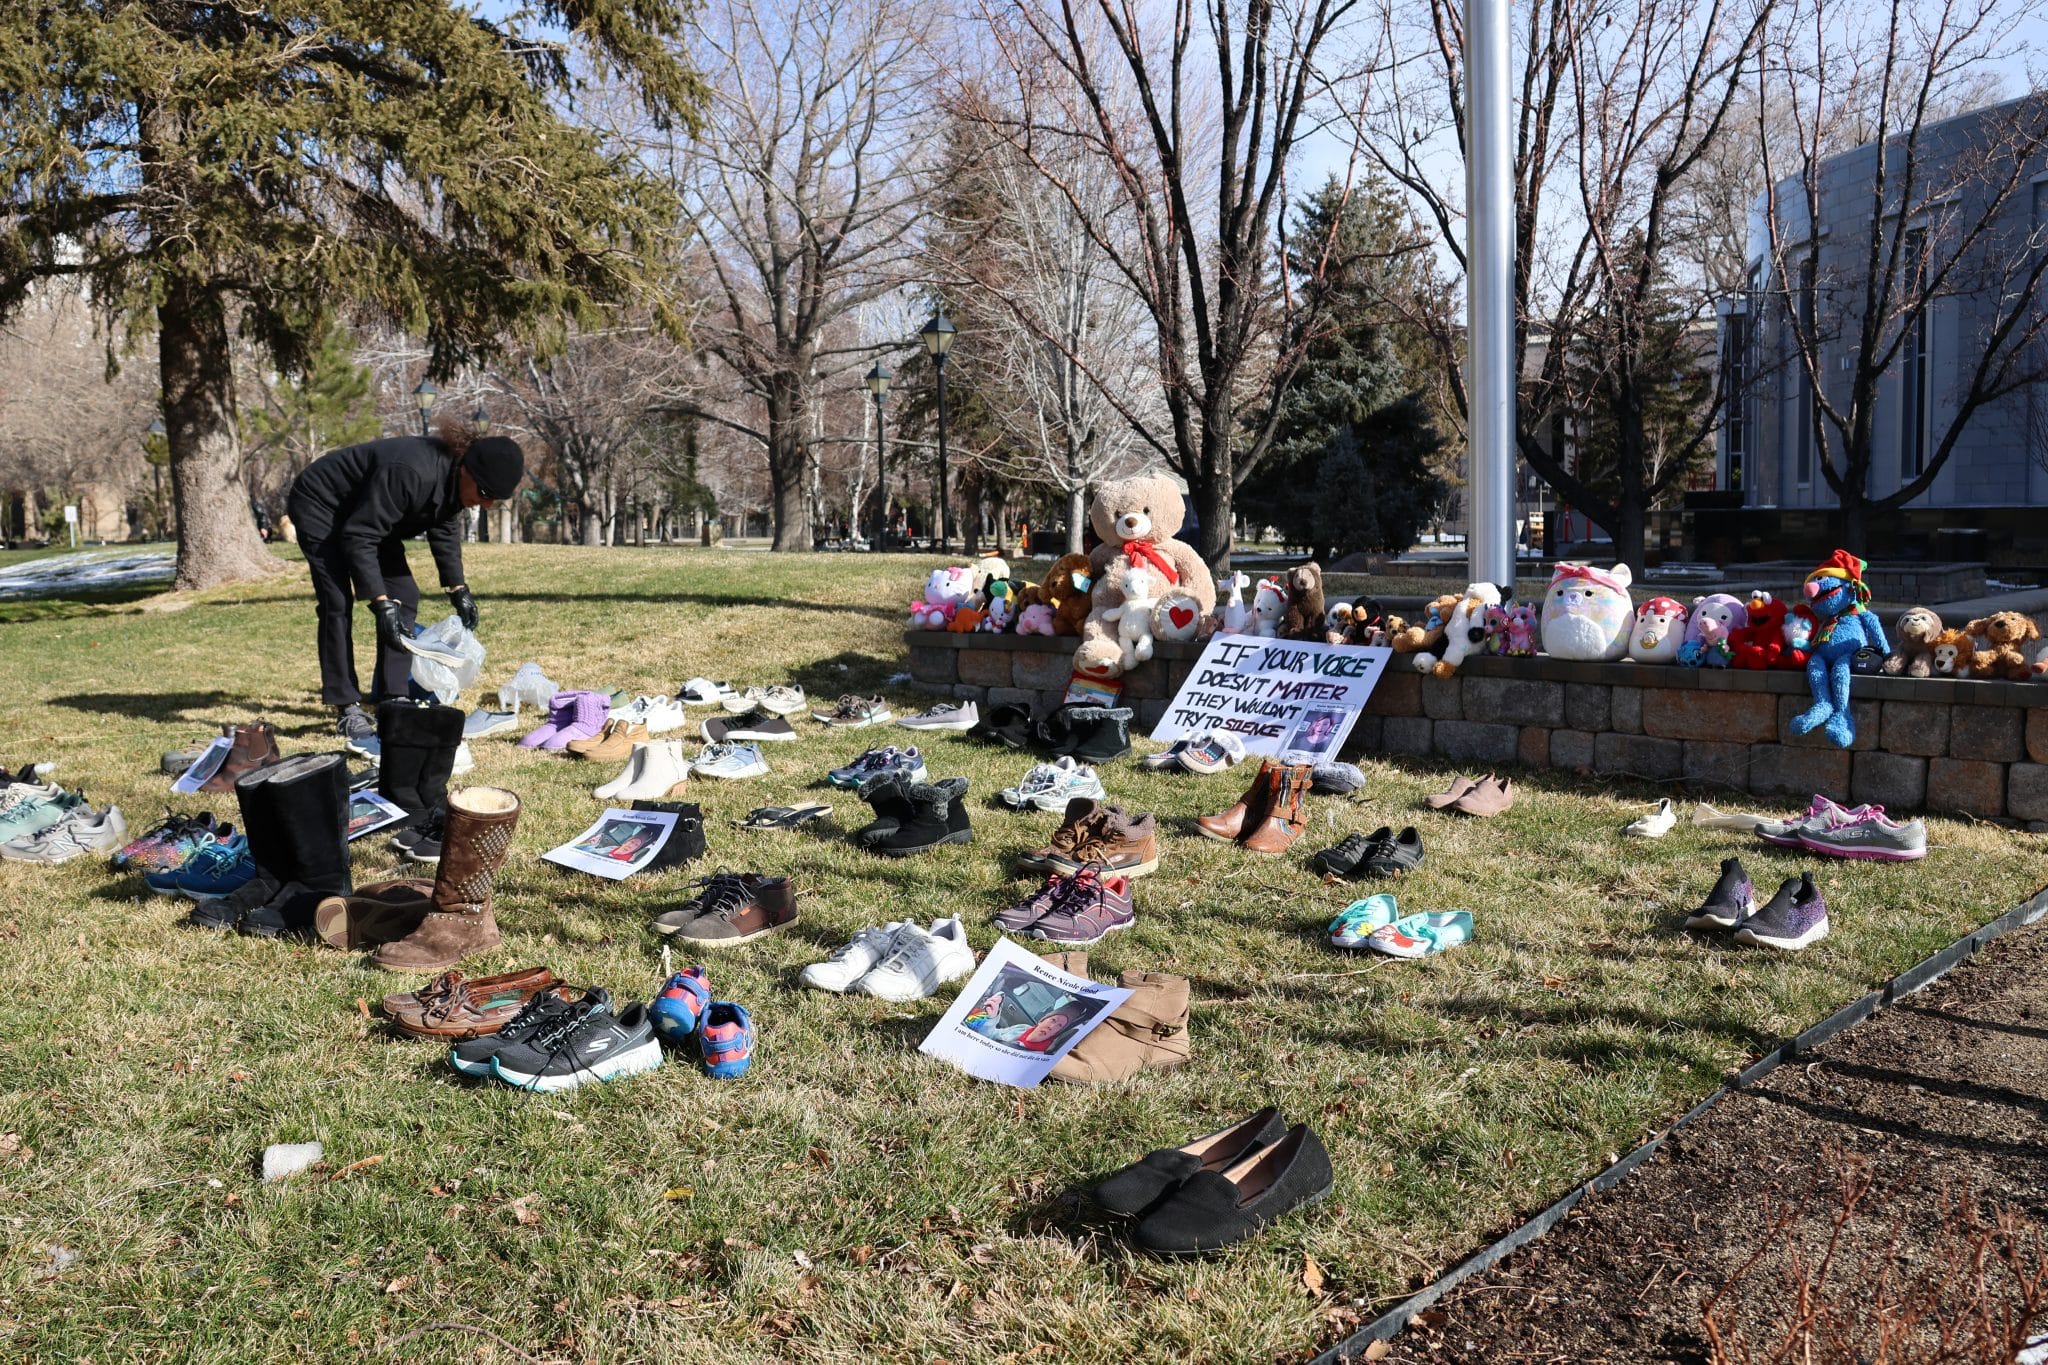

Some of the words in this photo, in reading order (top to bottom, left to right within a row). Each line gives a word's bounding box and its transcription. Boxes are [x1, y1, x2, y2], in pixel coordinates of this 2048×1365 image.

[1211, 643, 1260, 668] IF
[1258, 648, 1309, 674] YOUR
[1313, 653, 1375, 678] VOICE
[1267, 680, 1348, 700] MATTER
[1186, 692, 1233, 710] THEY
[1234, 698, 1302, 720] WOULDN'T
[1174, 709, 1208, 727] TRY
[1204, 716, 1224, 729] TO
[1220, 718, 1286, 738] SILENCE
[1033, 965, 1057, 980] Renee
[1057, 977, 1080, 990] Nicole
[1080, 986, 1100, 995] Good
[966, 1032, 980, 1043] here
[979, 1039, 995, 1051] today
